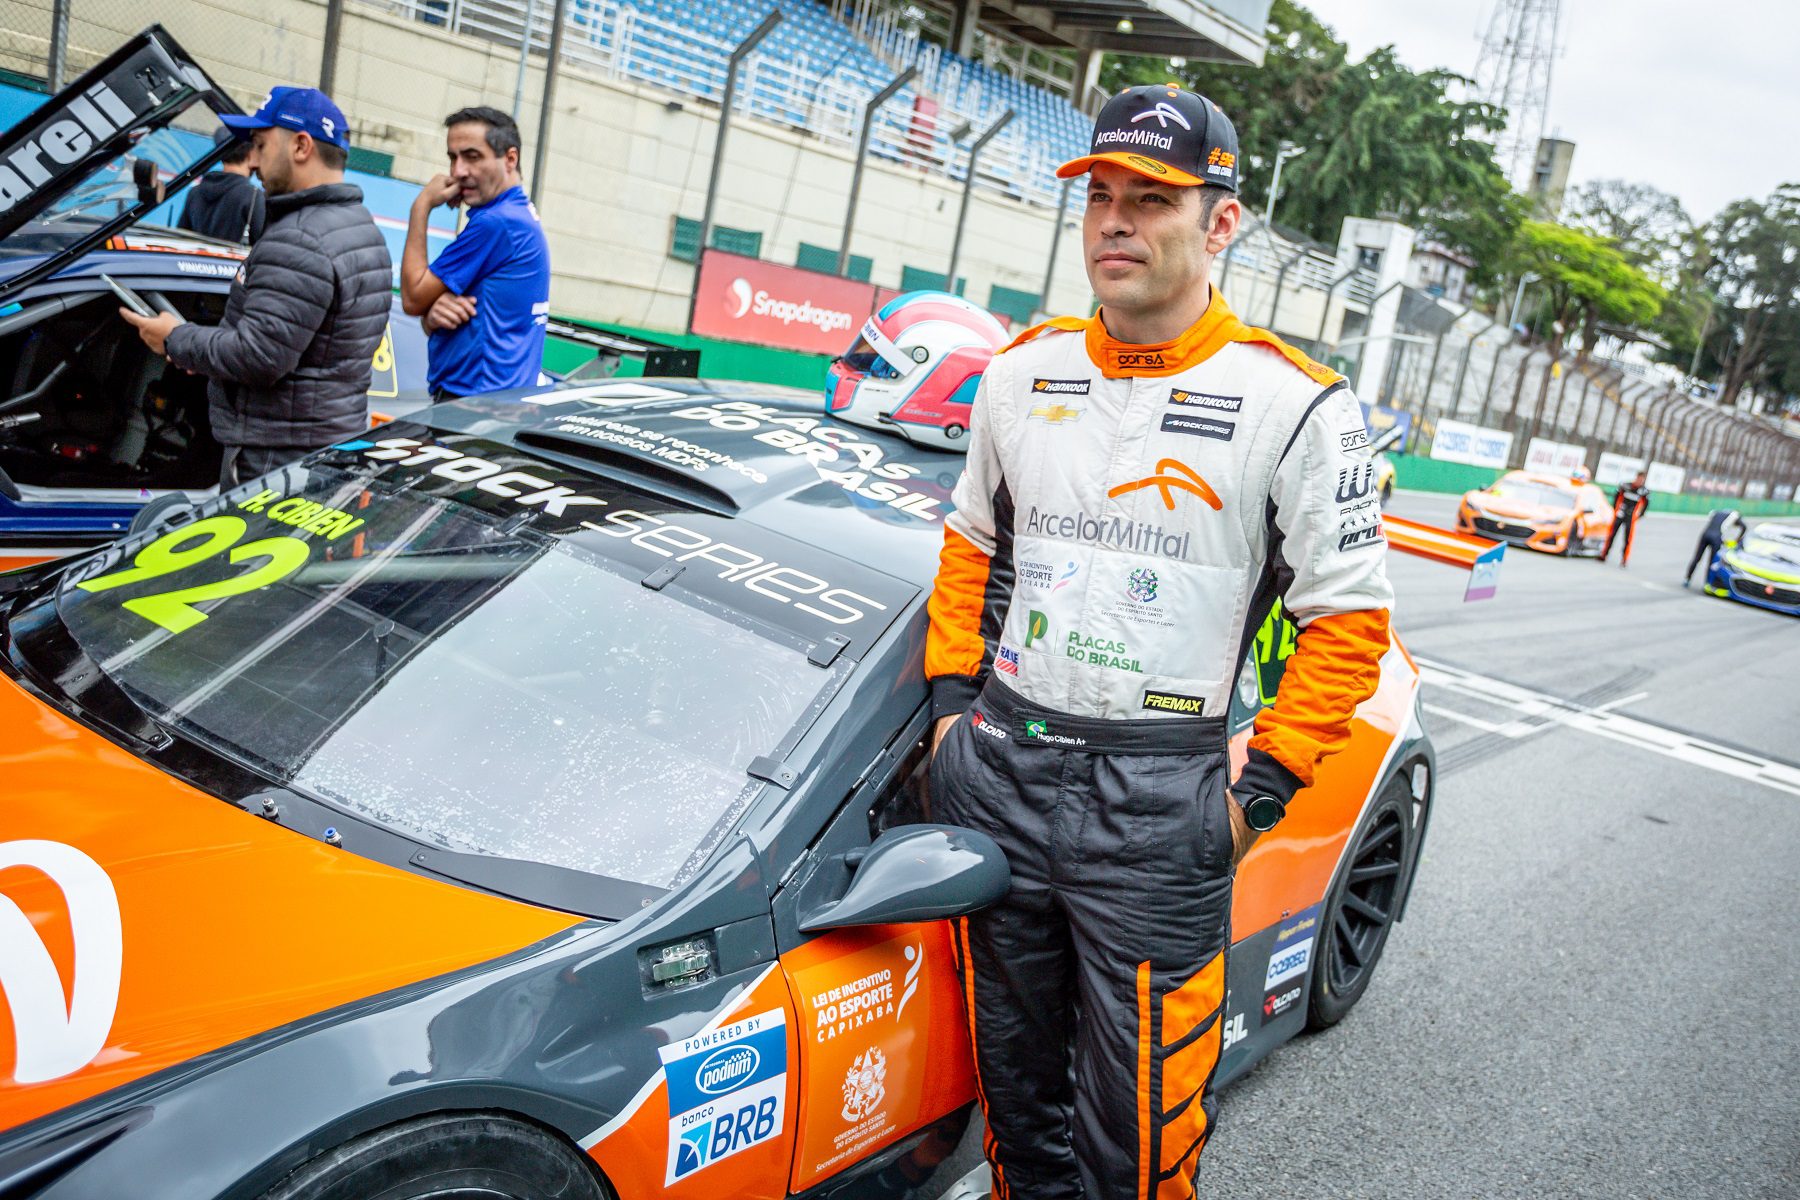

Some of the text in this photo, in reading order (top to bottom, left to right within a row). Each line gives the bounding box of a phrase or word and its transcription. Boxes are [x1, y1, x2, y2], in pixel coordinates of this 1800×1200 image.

[1095, 128, 1173, 151] ArcelorMittal
[1207, 147, 1236, 168] #92
[752, 290, 852, 332] Snapdragon
[559, 424, 710, 472] em nossos MDFs
[638, 430, 665, 441] se
[662, 437, 768, 484] reconhece
[712, 402, 921, 480] PLACAS
[1341, 433, 1366, 447] cors
[364, 438, 608, 517] STOCK
[670, 406, 941, 521] DO BRASIL
[1335, 462, 1375, 503] W
[238, 488, 365, 541] H. CIBIEN
[1026, 506, 1190, 560] ArcelorMittal
[77, 516, 310, 633] 92
[1066, 645, 1143, 673] DO BRASIL
[1068, 631, 1126, 654] PLACAS
[1145, 693, 1202, 714] FREMAX
[1037, 732, 1055, 743] Hugo
[1076, 737, 1086, 746] A+
[812, 969, 891, 1009] LEI DE INCENTIVO
[817, 982, 893, 1028] AO ESPORTE
[685, 1018, 761, 1052] POWERED BY
[817, 1002, 894, 1043] CAPIXABA
[1223, 1012, 1248, 1050] SIL
[703, 1055, 751, 1090] podium
[681, 1106, 714, 1128] banco
[710, 1095, 777, 1160] BRB
